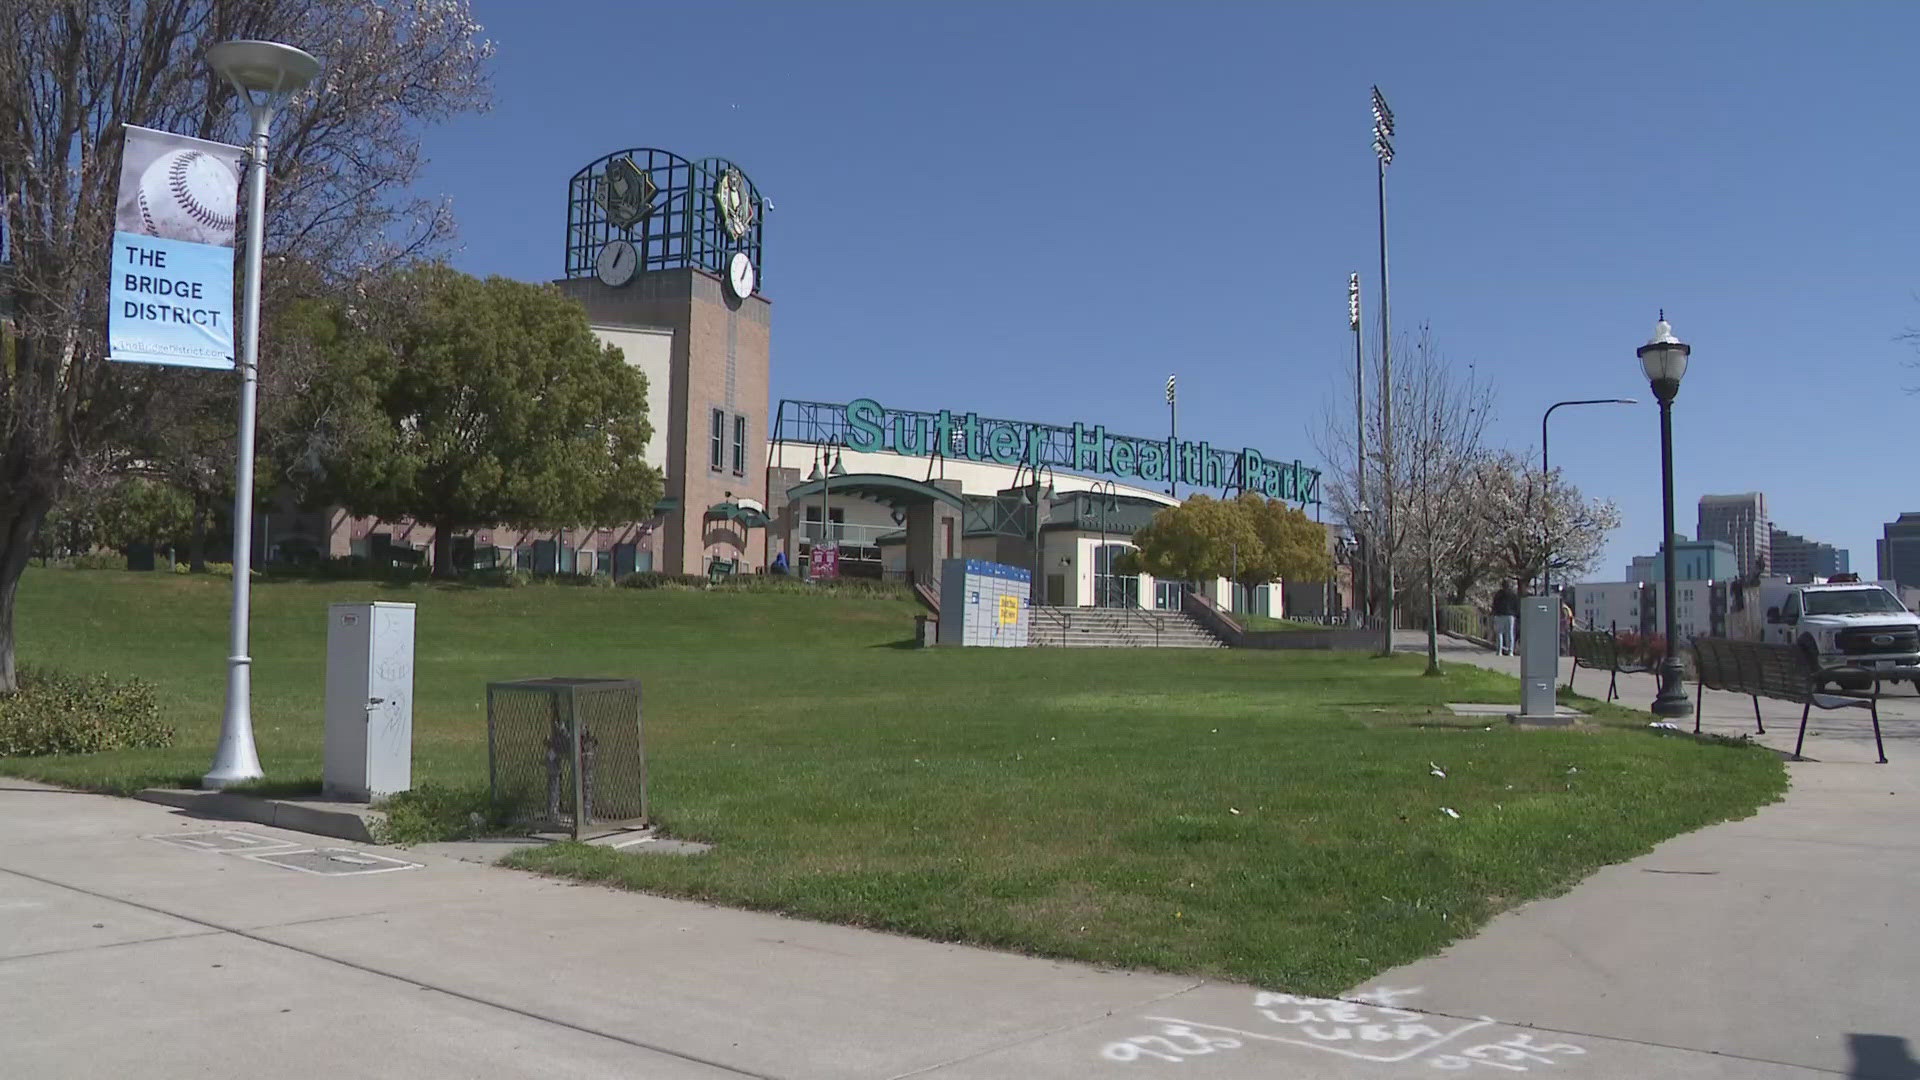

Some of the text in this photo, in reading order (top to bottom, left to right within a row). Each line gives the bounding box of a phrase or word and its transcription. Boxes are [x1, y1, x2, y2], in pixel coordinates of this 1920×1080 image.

[125, 246, 167, 269] THE
[124, 274, 203, 300] BRIDGE
[124, 302, 221, 327] DISTRICT
[844, 397, 1317, 504] Sutter Health Park
